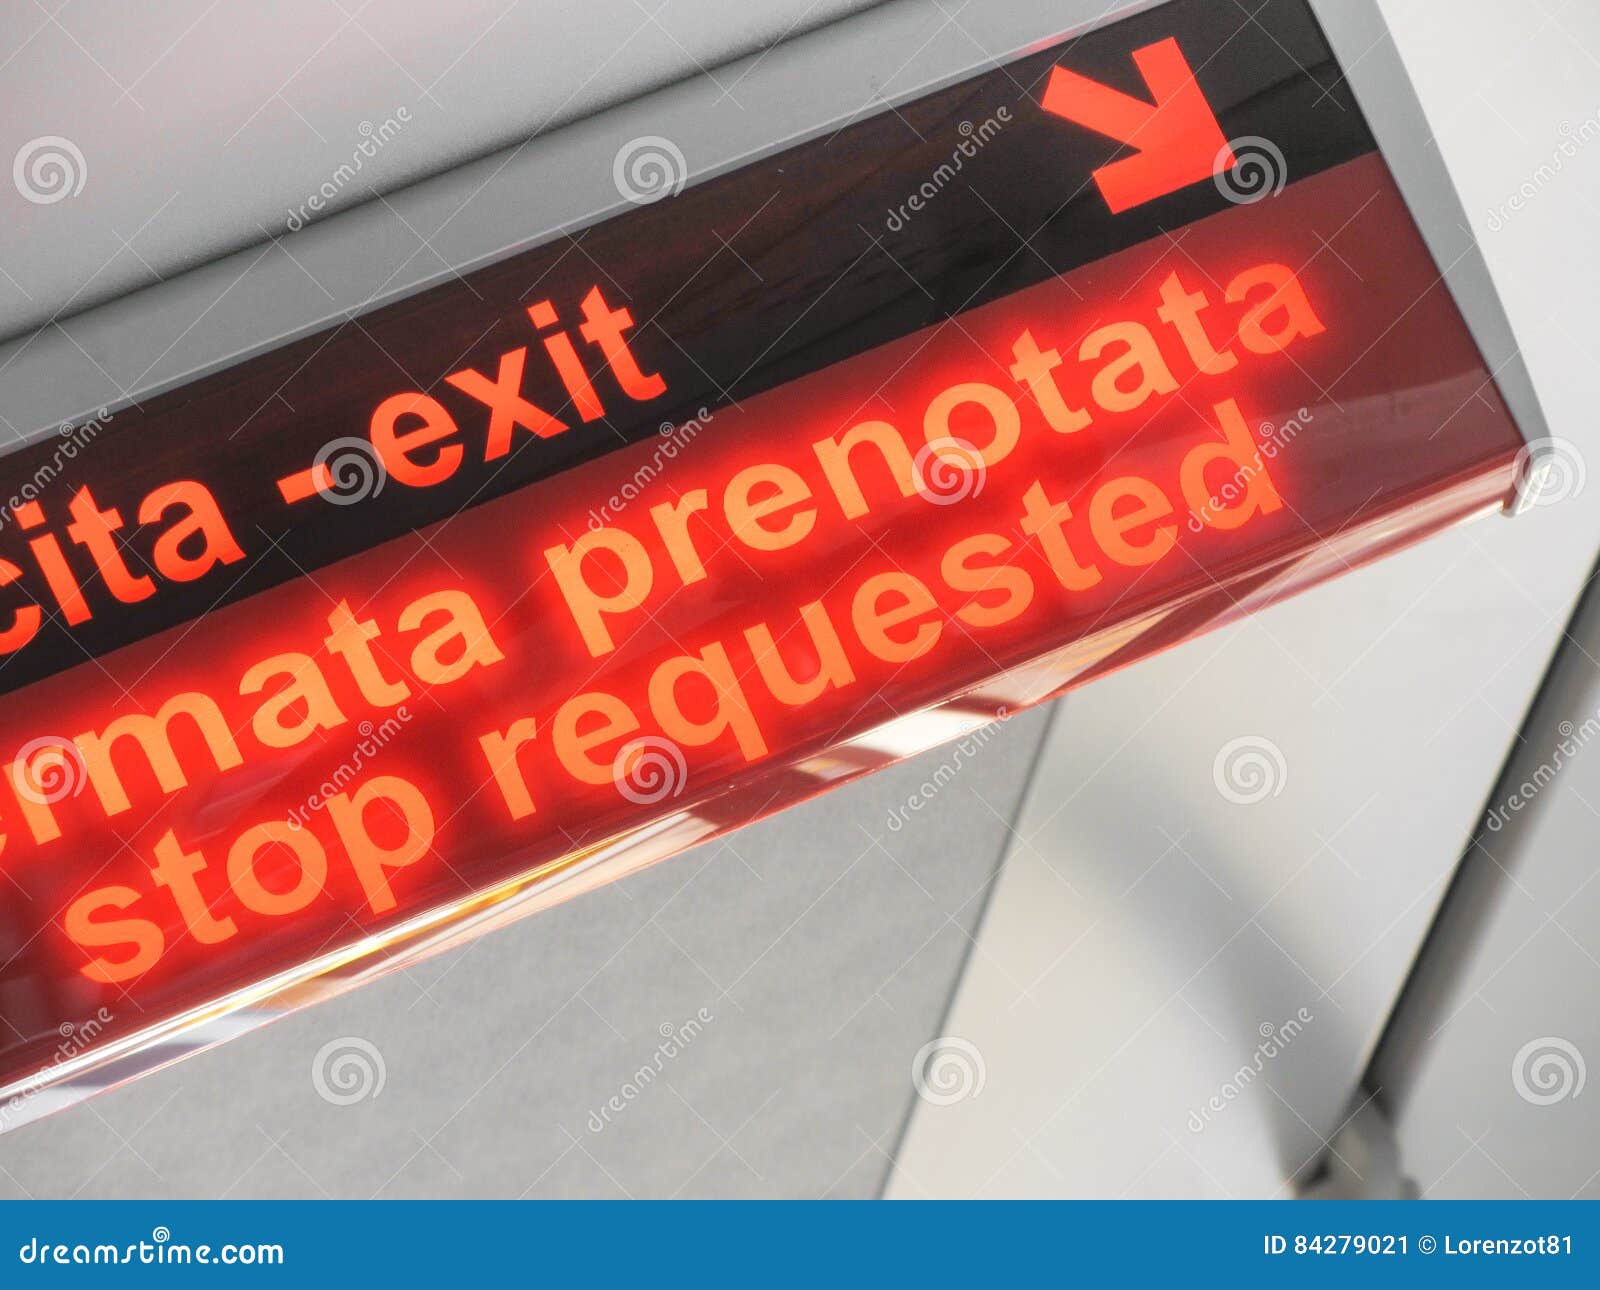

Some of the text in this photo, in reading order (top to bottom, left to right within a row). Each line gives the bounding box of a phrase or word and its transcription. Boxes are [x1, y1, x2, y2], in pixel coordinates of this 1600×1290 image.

[0, 262, 1326, 857] rmata prenotata
[62, 397, 1285, 986] stop requested
